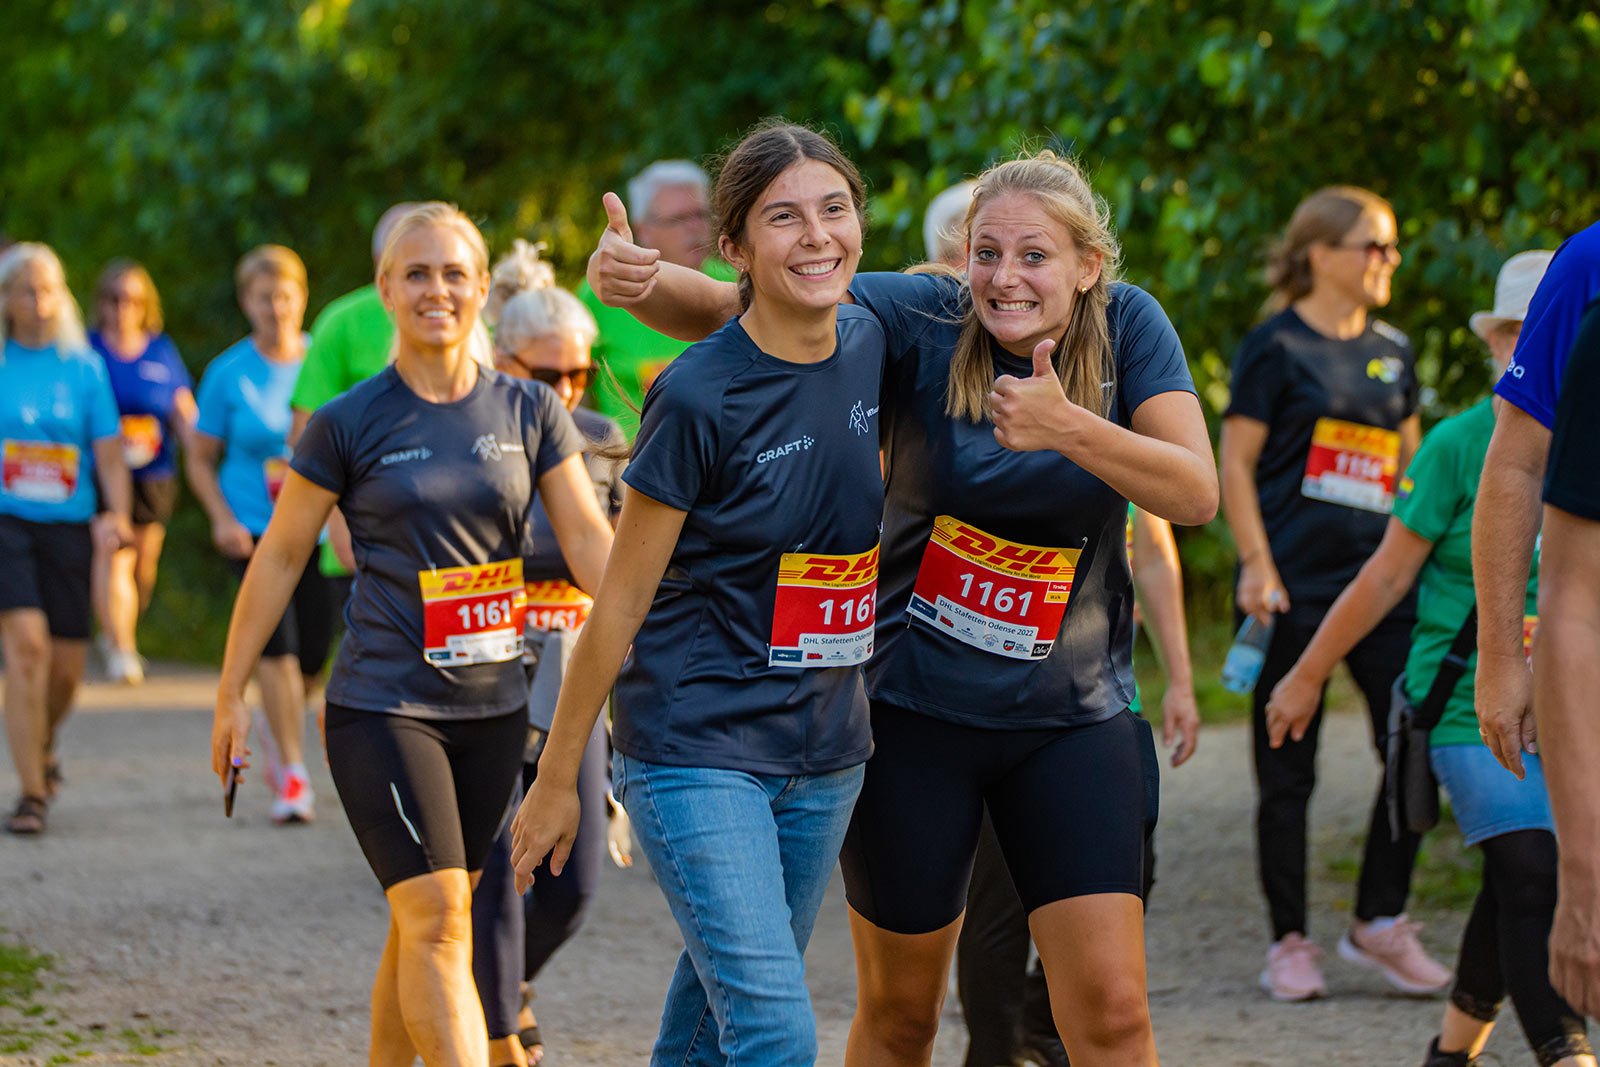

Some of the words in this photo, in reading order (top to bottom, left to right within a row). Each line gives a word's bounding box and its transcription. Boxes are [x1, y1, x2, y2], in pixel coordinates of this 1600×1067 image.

[381, 450, 420, 465] CRAFT
[756, 439, 802, 464] CRAFT
[800, 549, 879, 582] DH
[950, 525, 1060, 575] DHL
[441, 565, 515, 593] DHL
[819, 588, 877, 625] 1161
[959, 573, 1033, 617] 1161
[457, 599, 511, 629] 1161
[939, 600, 953, 611] DHL
[954, 607, 987, 626] Stafetten
[987, 621, 1016, 635] Odense
[1017, 628, 1034, 637] 2022
[803, 637, 819, 645] DHL
[821, 635, 854, 645] Stafetten
